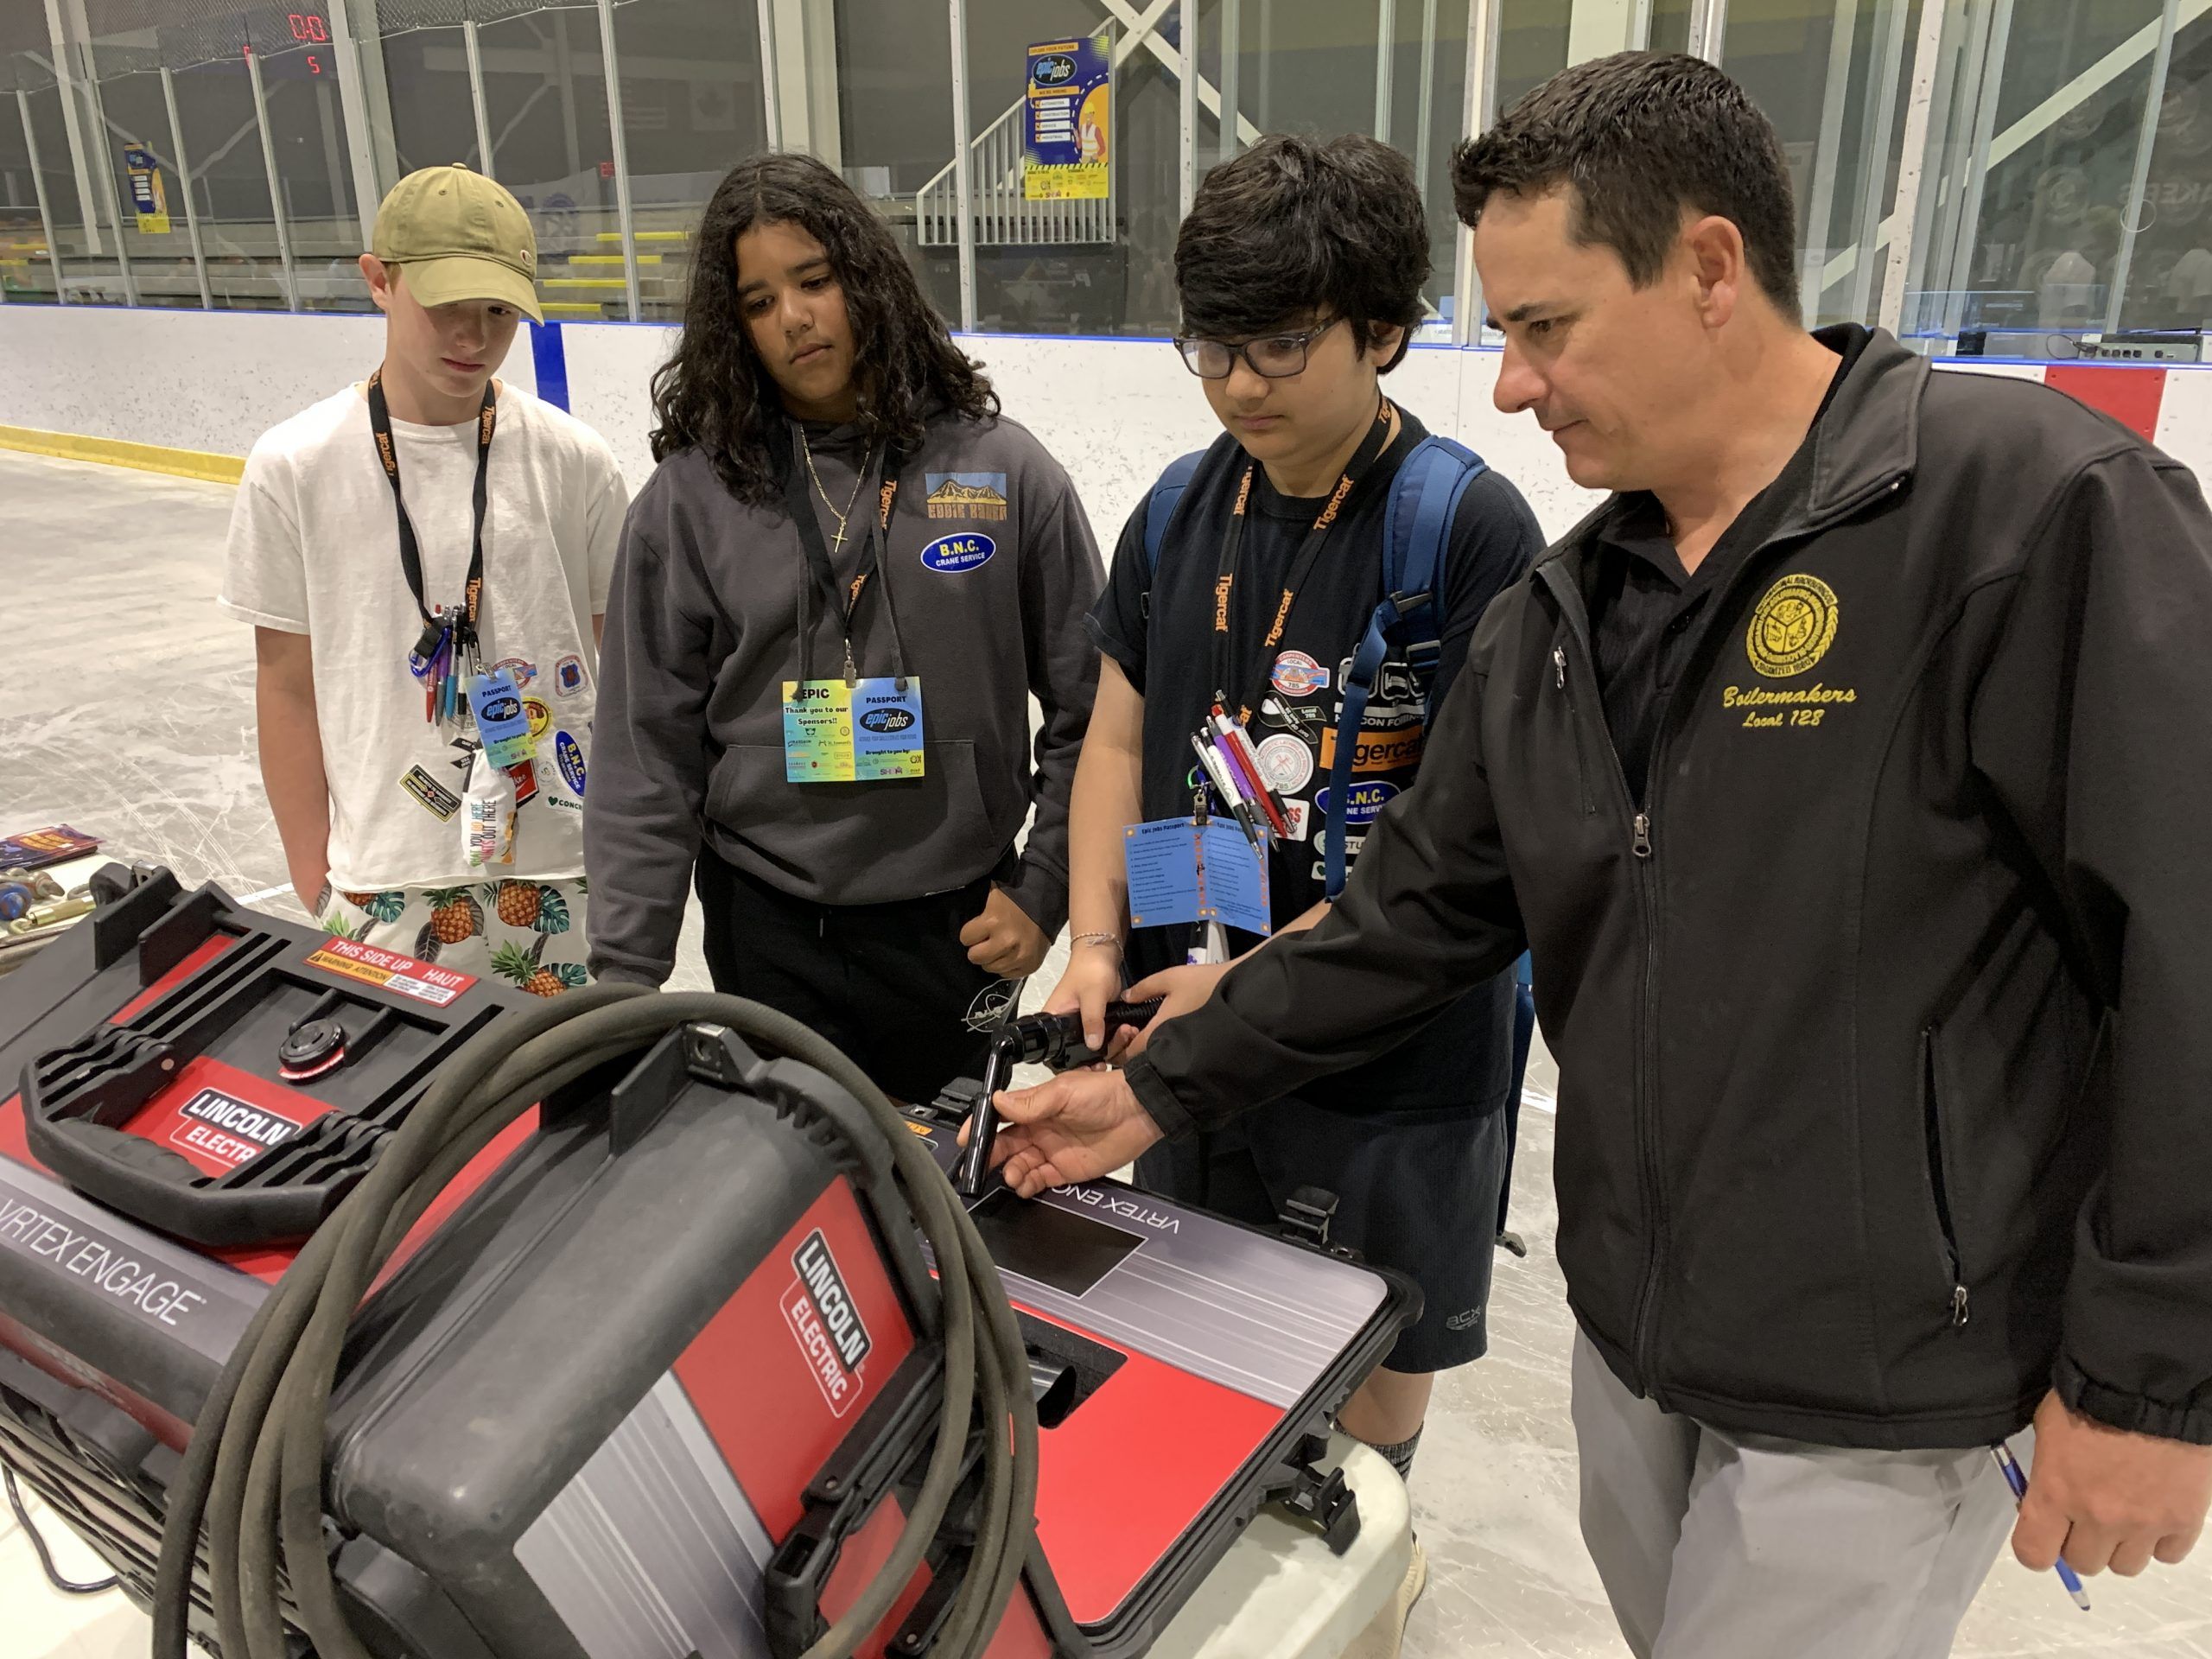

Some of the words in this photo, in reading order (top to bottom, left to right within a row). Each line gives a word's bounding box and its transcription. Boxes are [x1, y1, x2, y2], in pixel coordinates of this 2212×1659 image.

[482, 405, 496, 444] Tigercat
[1233, 467, 1253, 516] igercat
[1313, 474, 1355, 531] Tigercat
[936, 556, 959, 567] CRANE
[960, 552, 985, 563] SERVICE
[939, 539, 979, 556] B.N.C.
[467, 577, 481, 622] Tigercat
[1216, 573, 1233, 632] Tigercat
[1265, 588, 1294, 648] Tigercat
[481, 684, 512, 698] PASSPORT
[803, 689, 830, 699] EPIC
[866, 696, 906, 704] PASSPORT
[1723, 683, 1857, 708] Boilermakers
[798, 718, 837, 727] Sponsors!!
[1742, 711, 1783, 728] Local
[1790, 709, 1825, 727] 128
[559, 742, 570, 764] CRANE
[567, 763, 581, 789] SERVICE
[568, 743, 584, 781] B.N.C.
[471, 802, 483, 820] HERE
[483, 800, 497, 822] THERE
[1347, 788, 1385, 805] .N.C.
[470, 834, 484, 847] YOU
[483, 826, 496, 839] OUT
[331, 940, 363, 957] THIS
[359, 950, 394, 968] SIDE
[390, 959, 413, 972] UP
[422, 969, 465, 988] HAUT
[188, 1093, 292, 1146] LINCOLN
[185, 1125, 257, 1162] ELECTR
[1051, 1184, 1104, 1206] ENG
[1102, 1197, 1179, 1234] VRTEX
[0, 1198, 84, 1263] VRTEX
[66, 1241, 202, 1325] ENGAGE
[798, 1240, 866, 1366] LINCOLN
[791, 1294, 848, 1401] ELECTRIC
